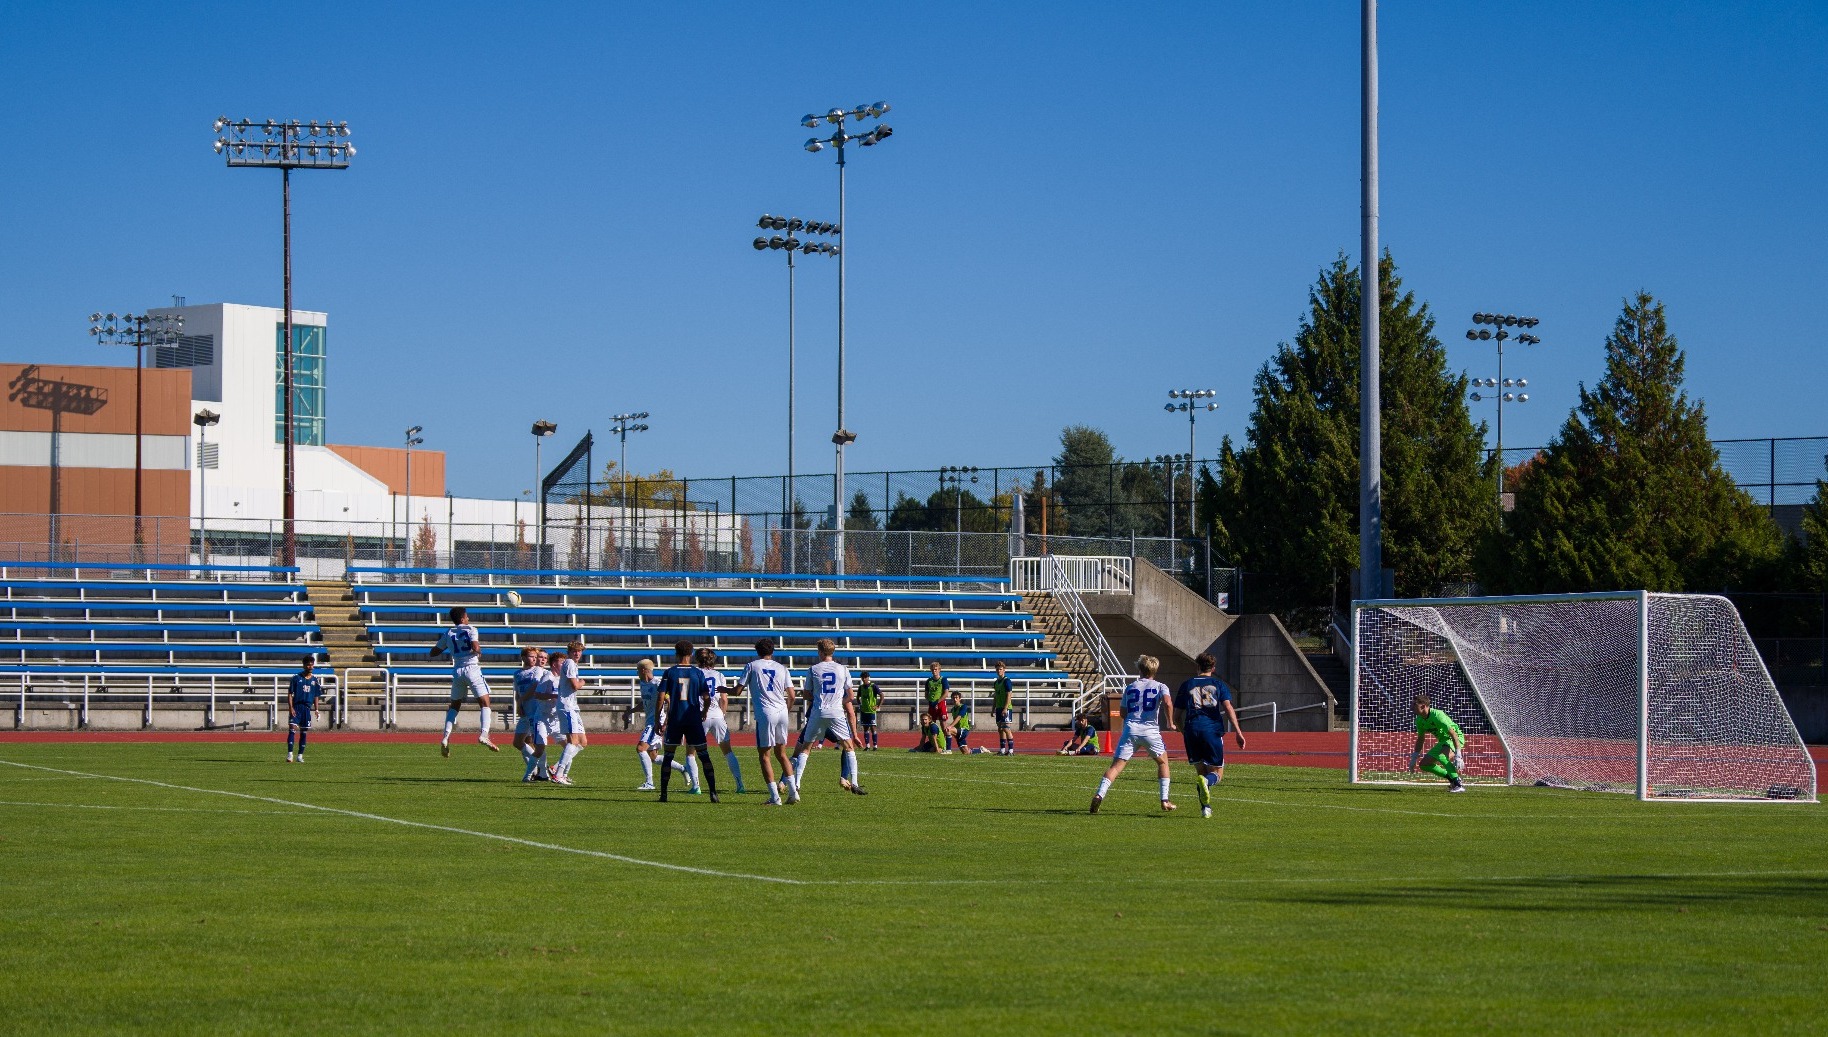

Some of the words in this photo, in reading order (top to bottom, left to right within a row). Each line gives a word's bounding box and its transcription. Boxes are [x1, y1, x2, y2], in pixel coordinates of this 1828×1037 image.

[451, 631, 471, 653] 13
[762, 669, 776, 691] 7
[822, 673, 836, 693] 2
[1127, 689, 1157, 713] 26
